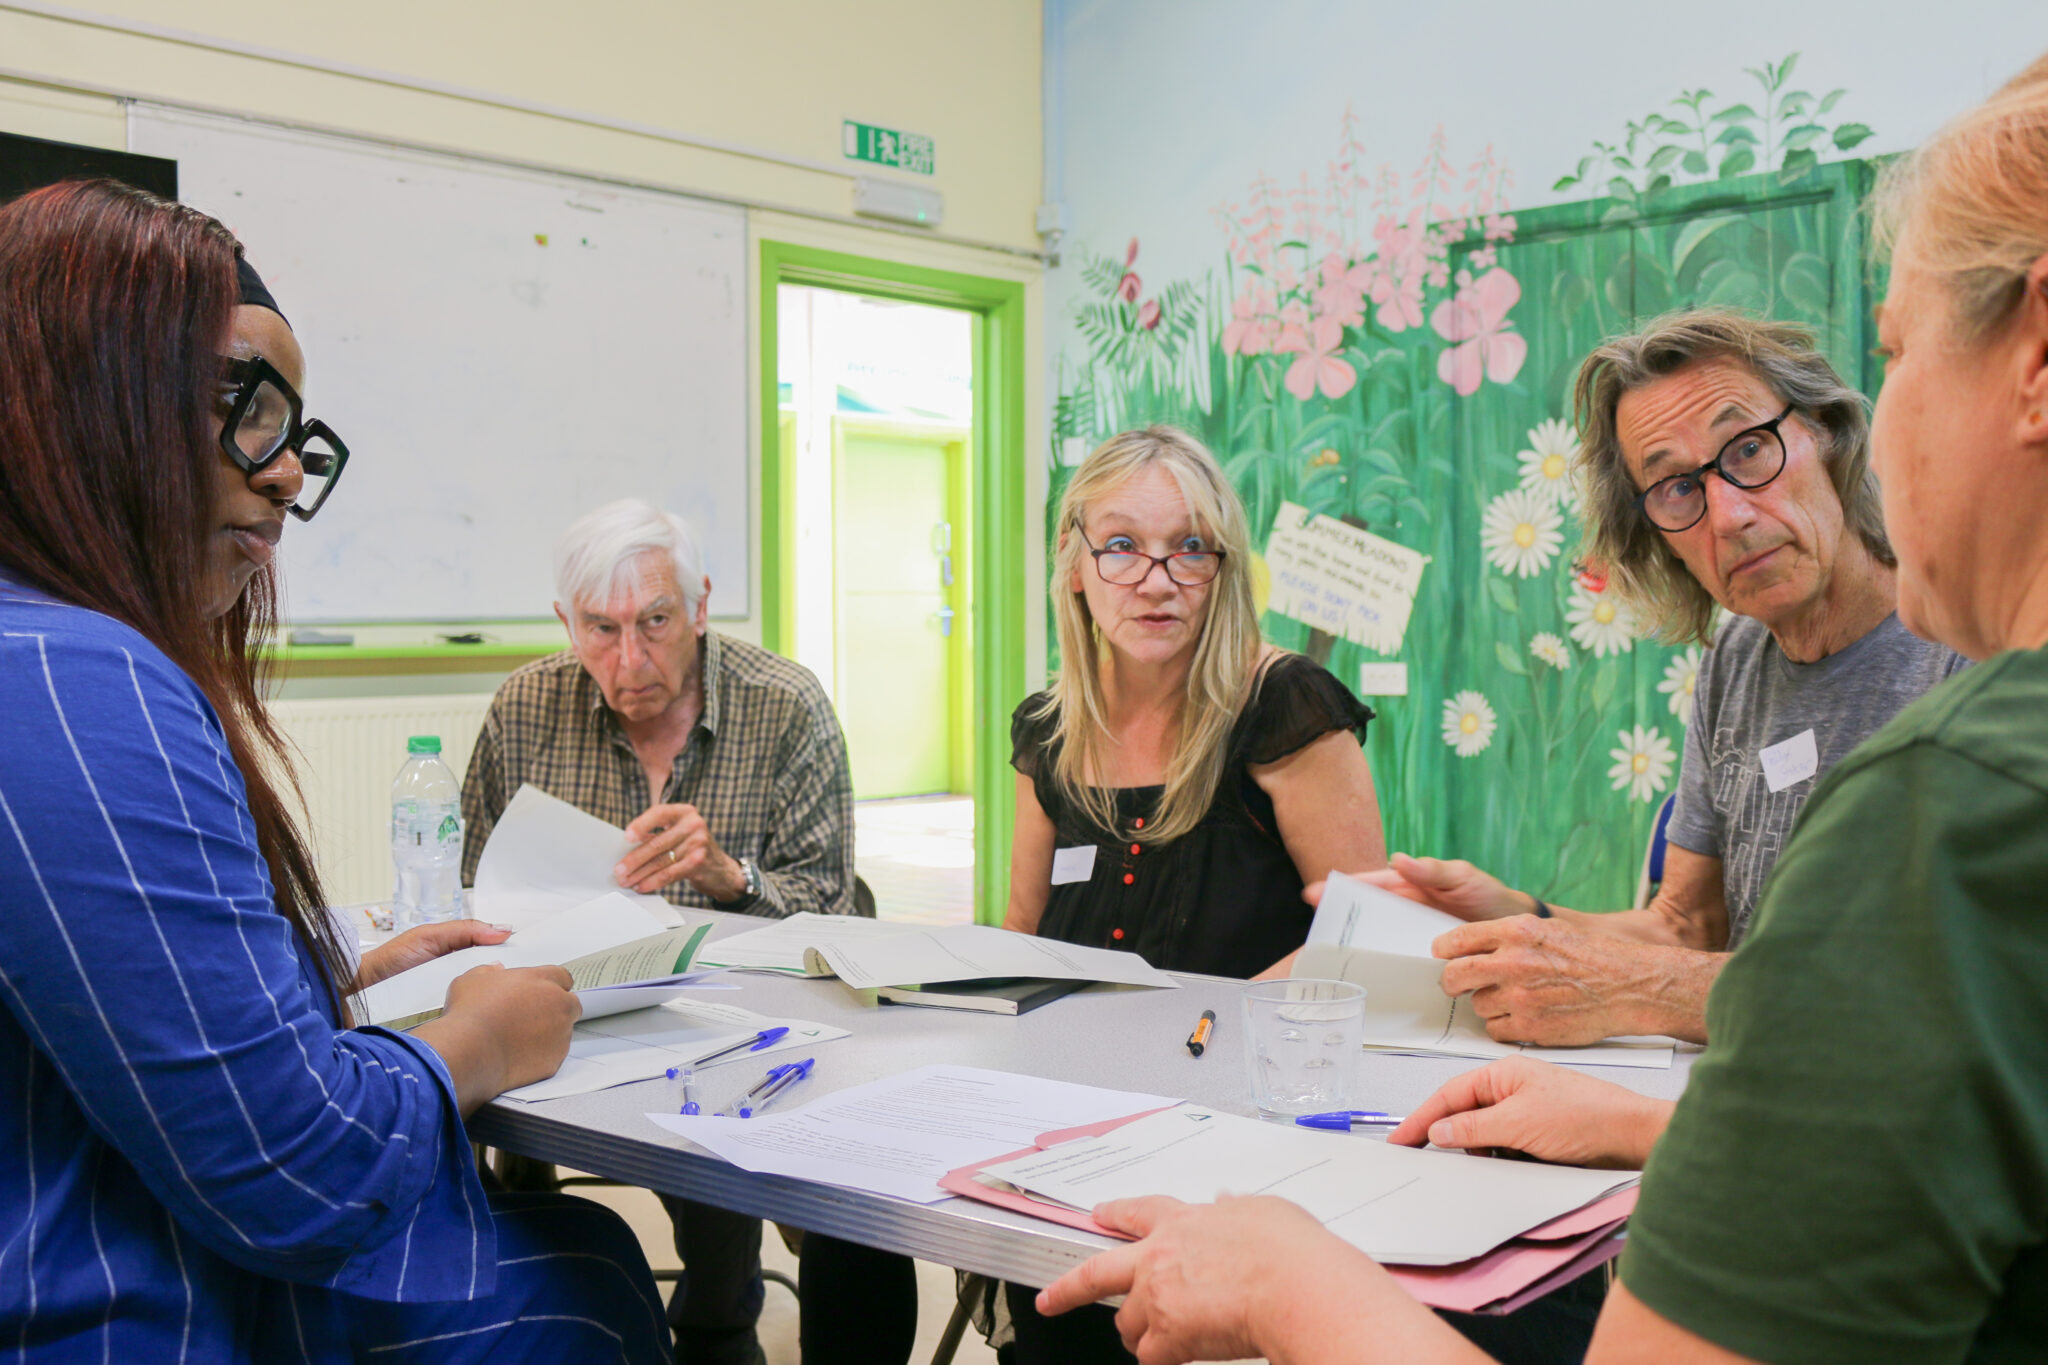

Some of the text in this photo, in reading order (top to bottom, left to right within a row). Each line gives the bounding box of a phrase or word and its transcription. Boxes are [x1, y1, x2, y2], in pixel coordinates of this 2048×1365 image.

[1279, 570, 1319, 596] PLEASE
[1358, 603, 1381, 624] PICK
[1301, 598, 1318, 614] ON
